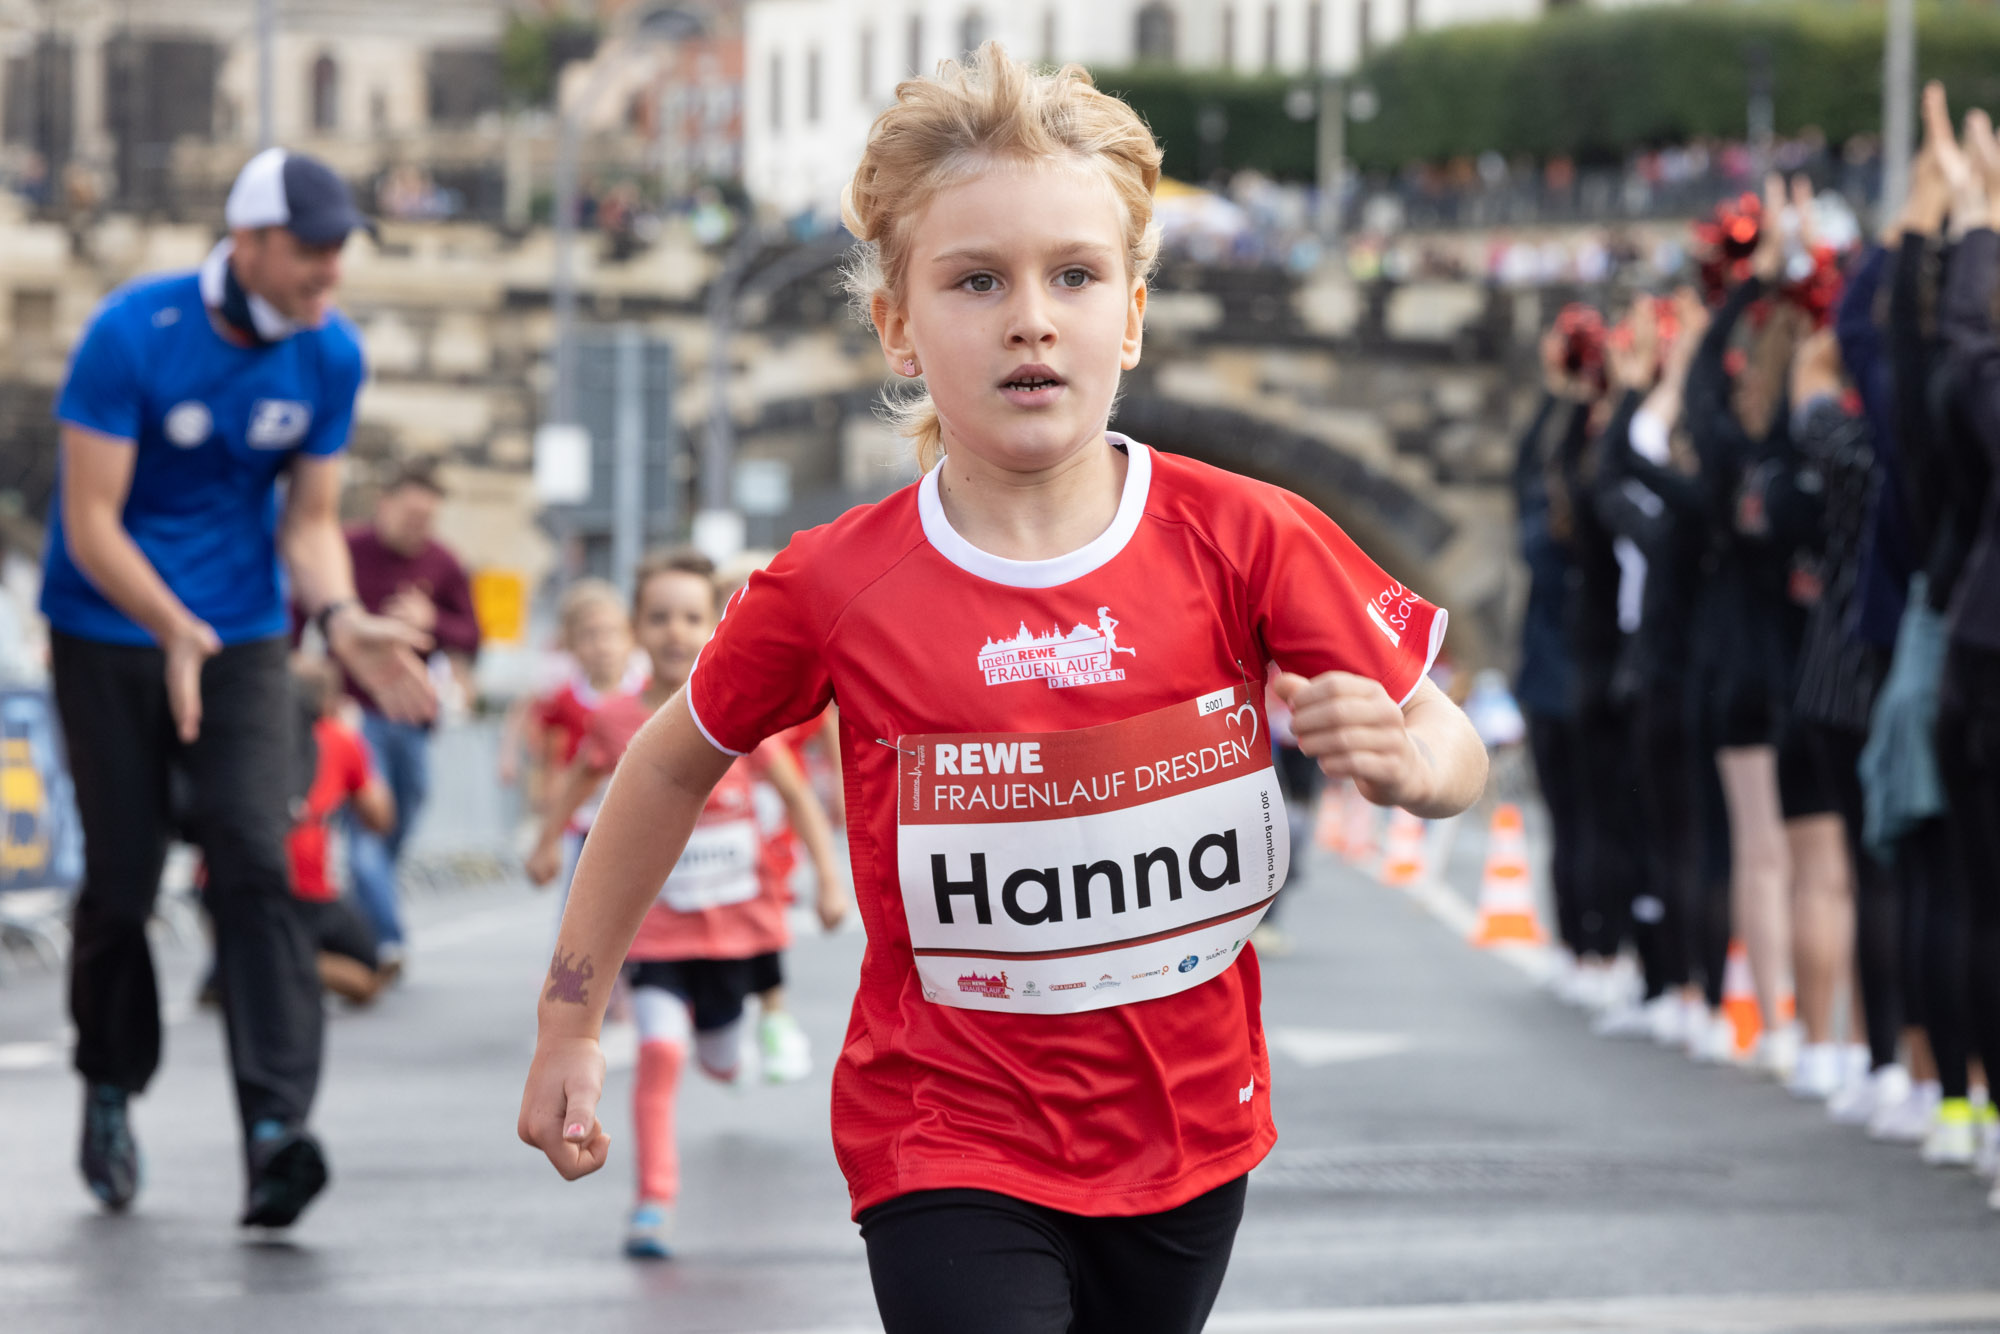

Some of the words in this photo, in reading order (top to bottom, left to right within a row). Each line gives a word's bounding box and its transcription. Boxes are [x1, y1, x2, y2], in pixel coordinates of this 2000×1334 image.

[1371, 580, 1408, 615] Lau
[981, 652, 1015, 669] mein
[1018, 647, 1057, 661] REWE
[987, 656, 1099, 684] FRAUENLAUF
[1050, 669, 1124, 688] DRESDEN
[1205, 697, 1224, 713] 5001
[935, 742, 1044, 776] REWE
[934, 770, 1126, 811] FRAUENLAUF
[1134, 735, 1251, 793] DRESDEN
[1260, 790, 1271, 810] 300
[1263, 812, 1271, 822] m
[1265, 825, 1276, 872] Bambina
[930, 828, 1241, 926] Hanna
[1267, 873, 1276, 893] Run
[1205, 948, 1228, 961] SUUNTO
